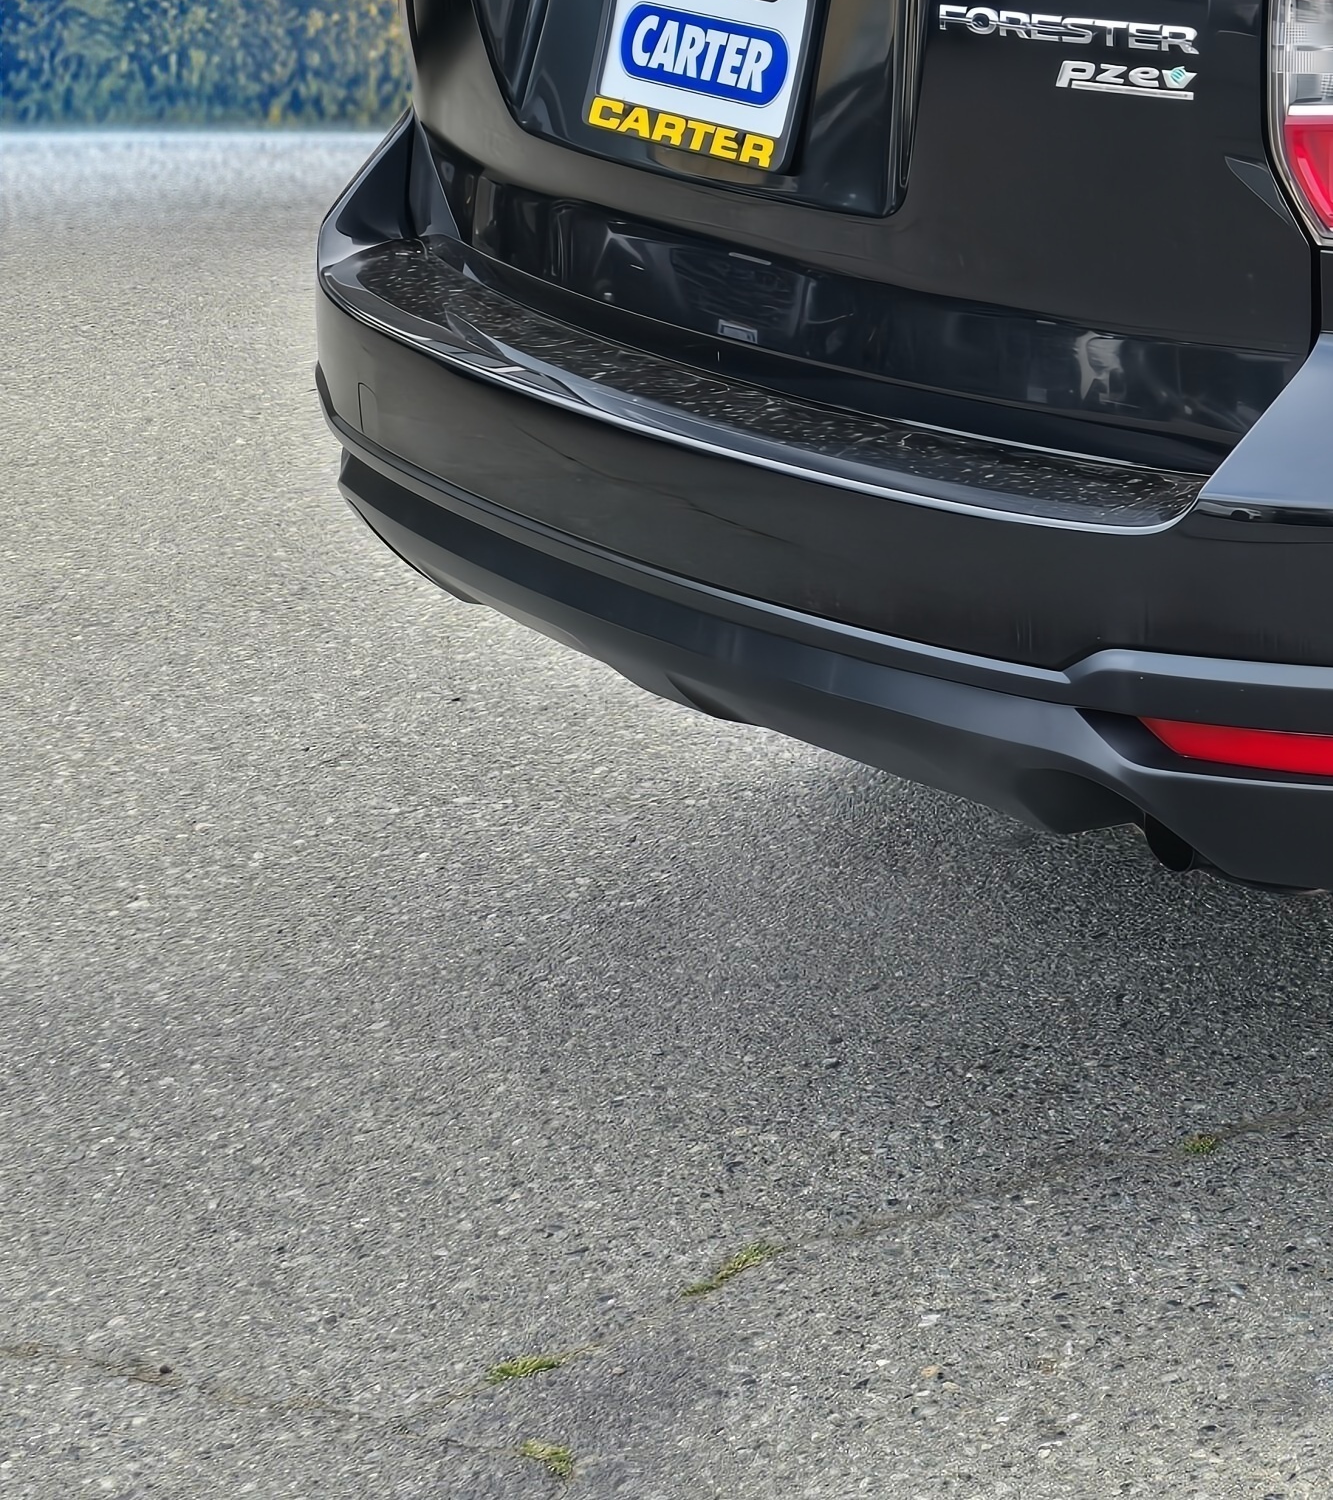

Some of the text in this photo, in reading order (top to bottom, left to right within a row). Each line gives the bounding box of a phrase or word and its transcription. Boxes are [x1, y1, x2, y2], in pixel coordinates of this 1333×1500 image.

[631, 14, 773, 94] CARTER
[939, 3, 1200, 55] FORESTER
[588, 96, 775, 168] CARTER
